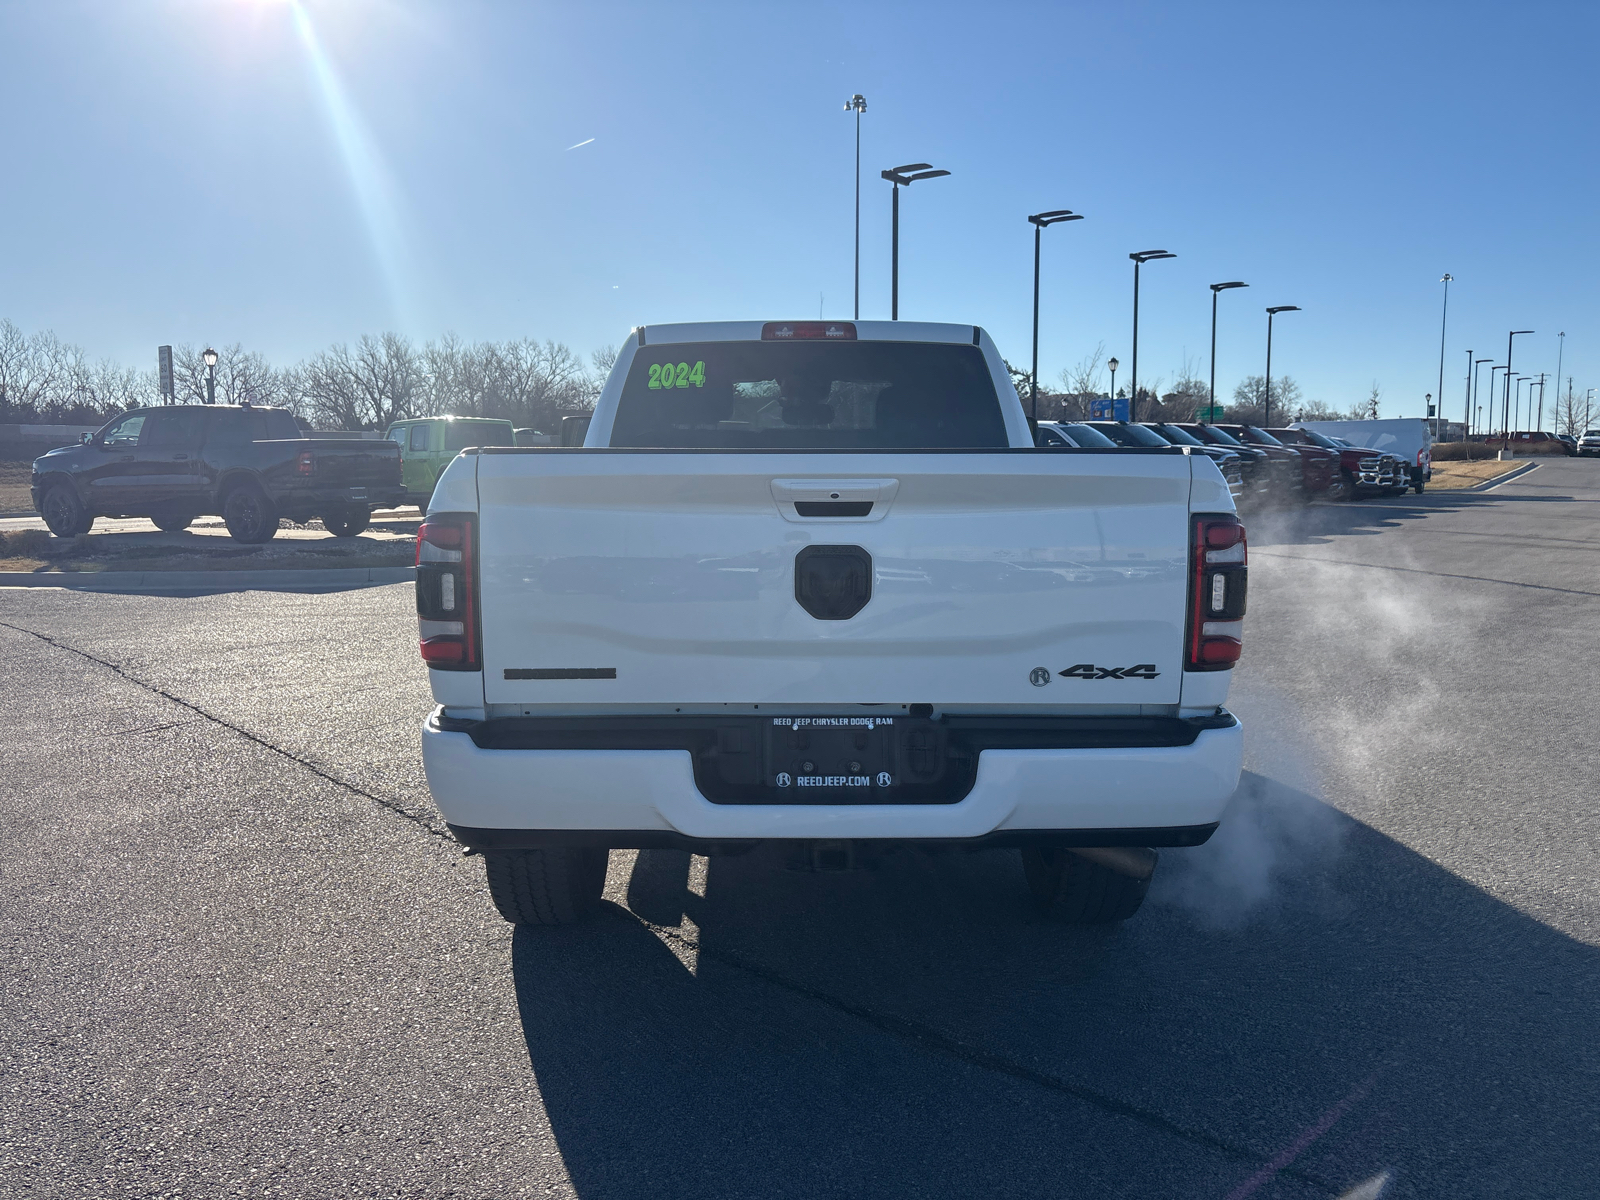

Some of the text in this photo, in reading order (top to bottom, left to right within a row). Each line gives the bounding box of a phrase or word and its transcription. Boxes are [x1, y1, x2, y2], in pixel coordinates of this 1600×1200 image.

[648, 360, 706, 390] 2024
[1058, 664, 1161, 679] 4x4
[773, 717, 893, 726] REED JEEP CHRYSLER DODGE RAM
[797, 776, 870, 787] REEDJEEP.COM
